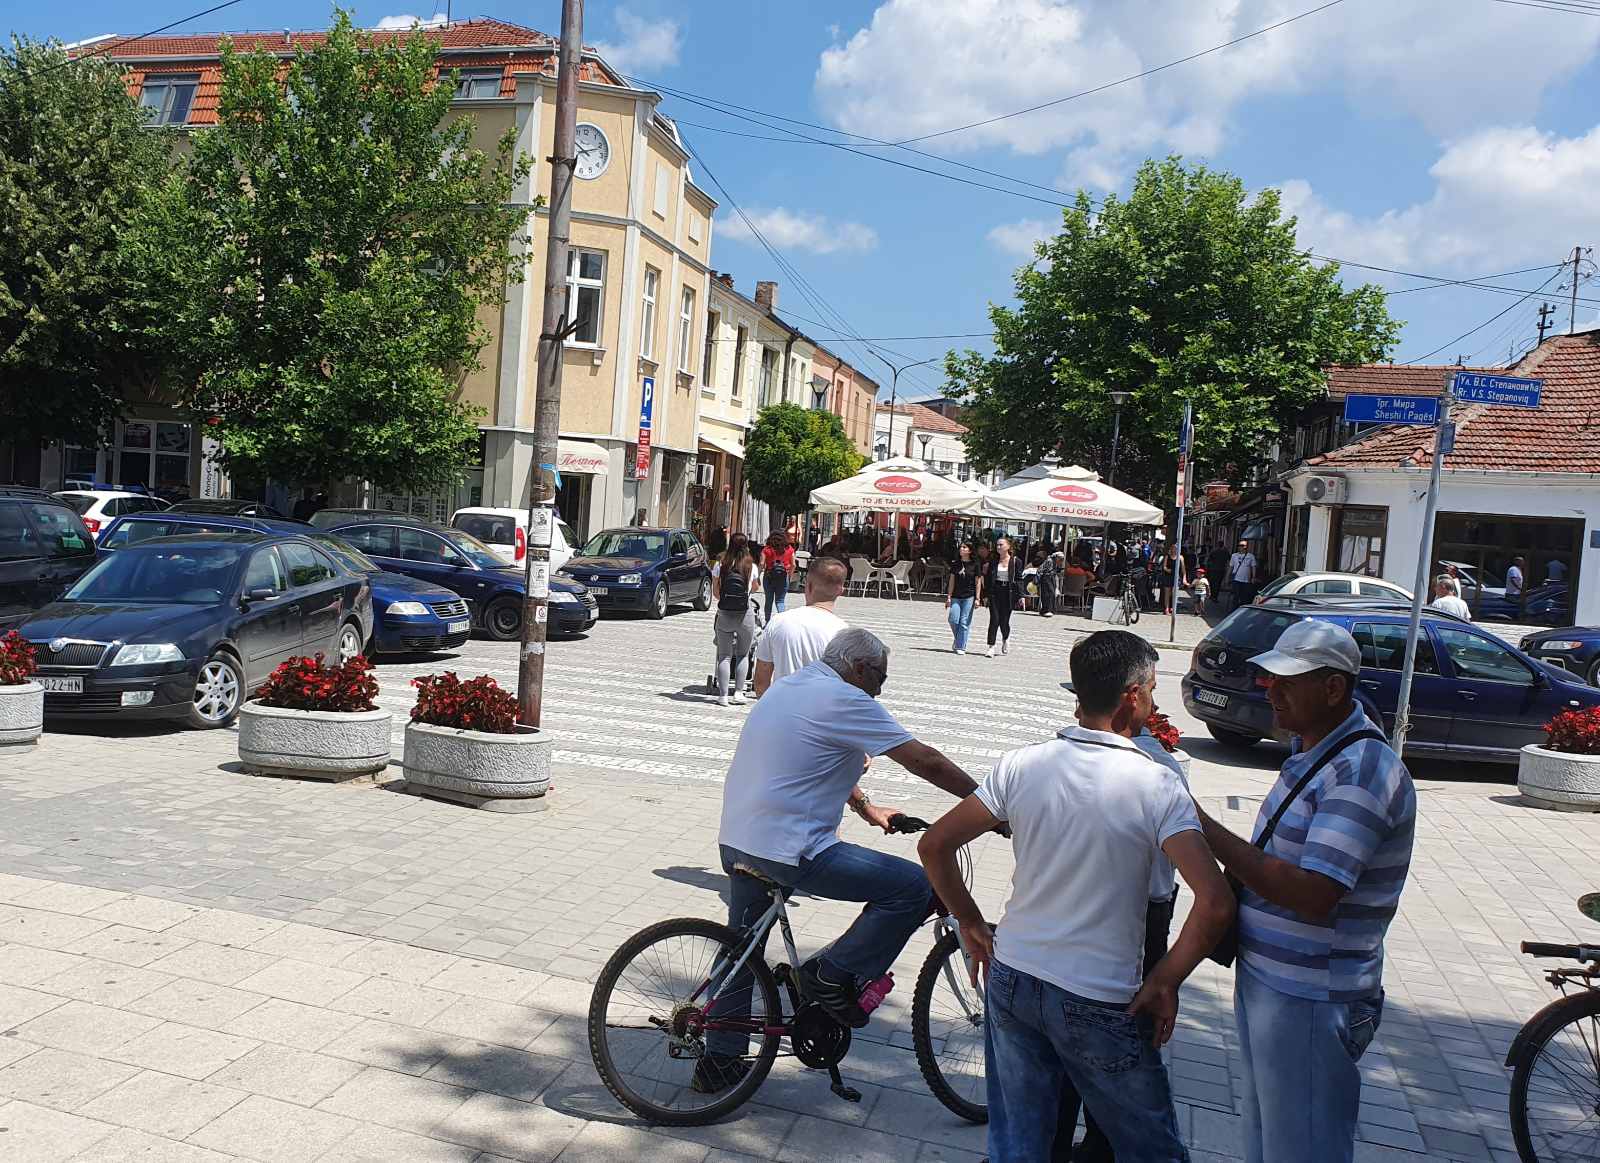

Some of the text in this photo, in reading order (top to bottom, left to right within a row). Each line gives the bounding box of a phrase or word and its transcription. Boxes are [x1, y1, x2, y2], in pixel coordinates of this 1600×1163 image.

[1460, 375, 1472, 386] Ул.
[644, 382, 652, 407] P
[1458, 387, 1529, 406] Rr. V.S. Stepanoviq
[1393, 399, 1416, 410] Мира
[1375, 410, 1402, 420] Sheshi
